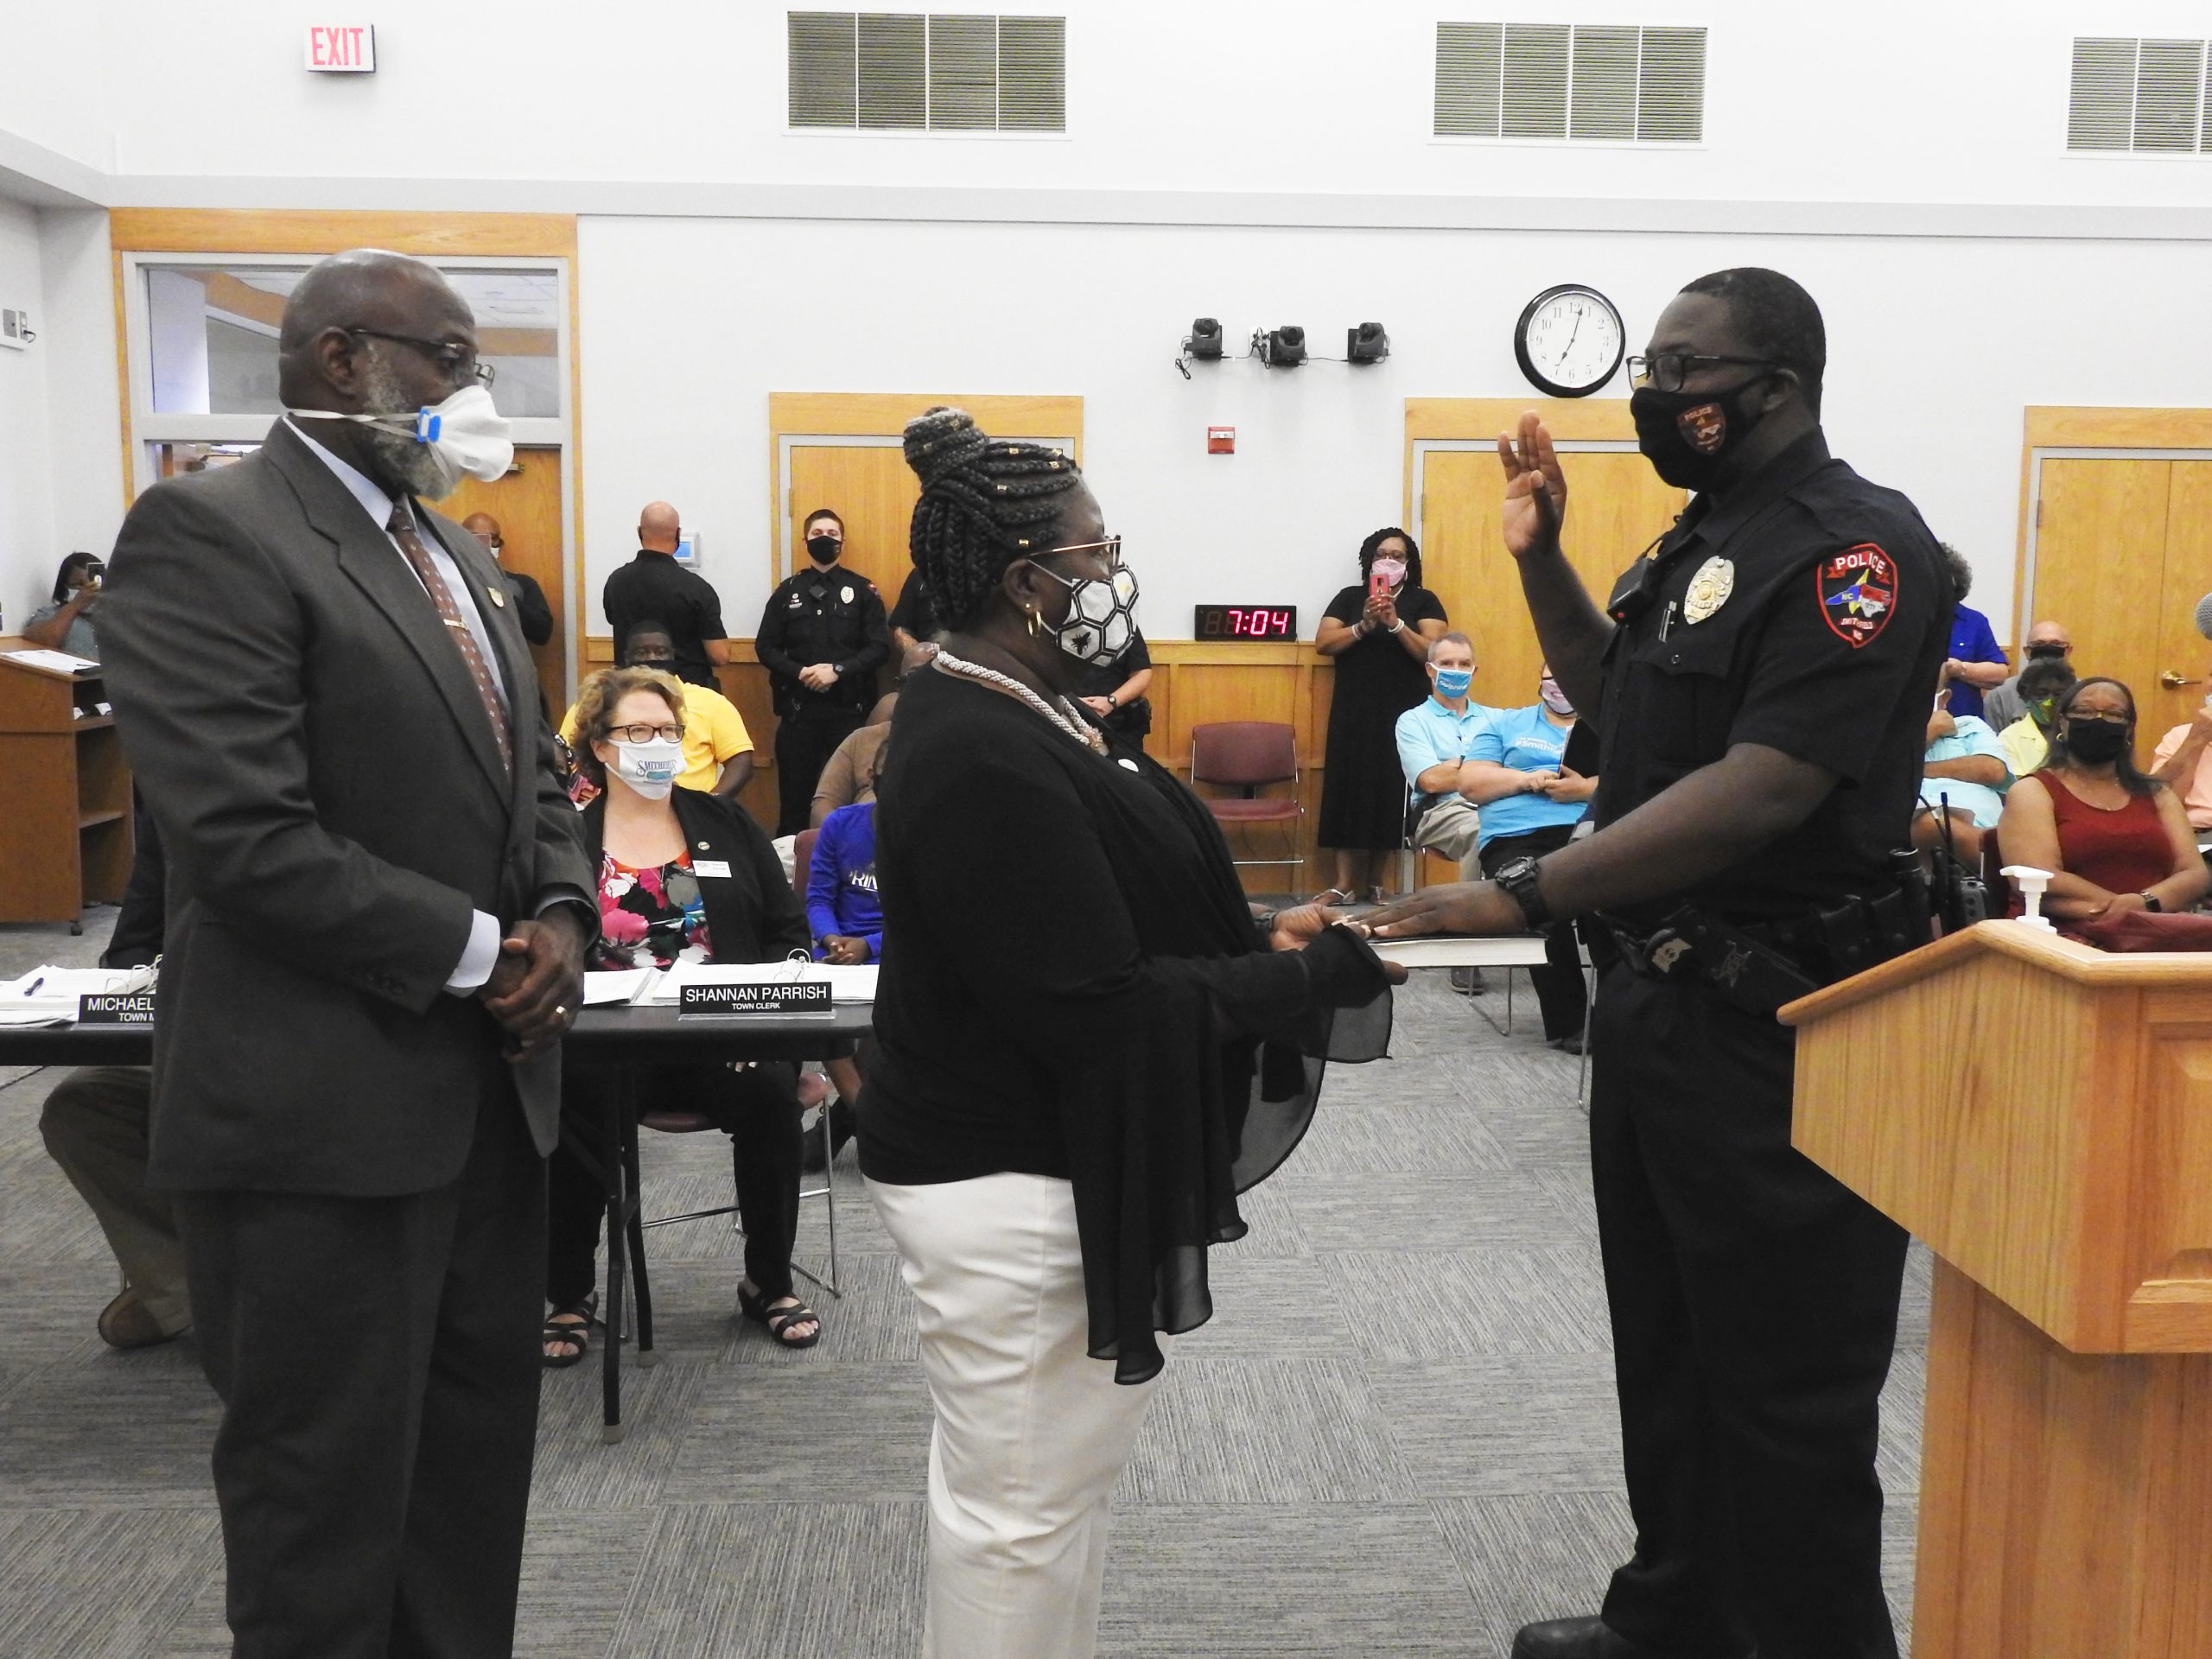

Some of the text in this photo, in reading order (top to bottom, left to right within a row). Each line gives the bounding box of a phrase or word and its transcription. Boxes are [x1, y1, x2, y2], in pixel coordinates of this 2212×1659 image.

[311, 27, 364, 66] EXIT
[1834, 552, 1886, 575] POLICE
[1228, 610, 1289, 635] 7:04
[685, 985, 827, 1002] SHANNAN PARRISH
[87, 997, 155, 1011] MICHAEL
[755, 1001, 781, 1010] CLERK
[118, 1012, 147, 1022] TOWN
